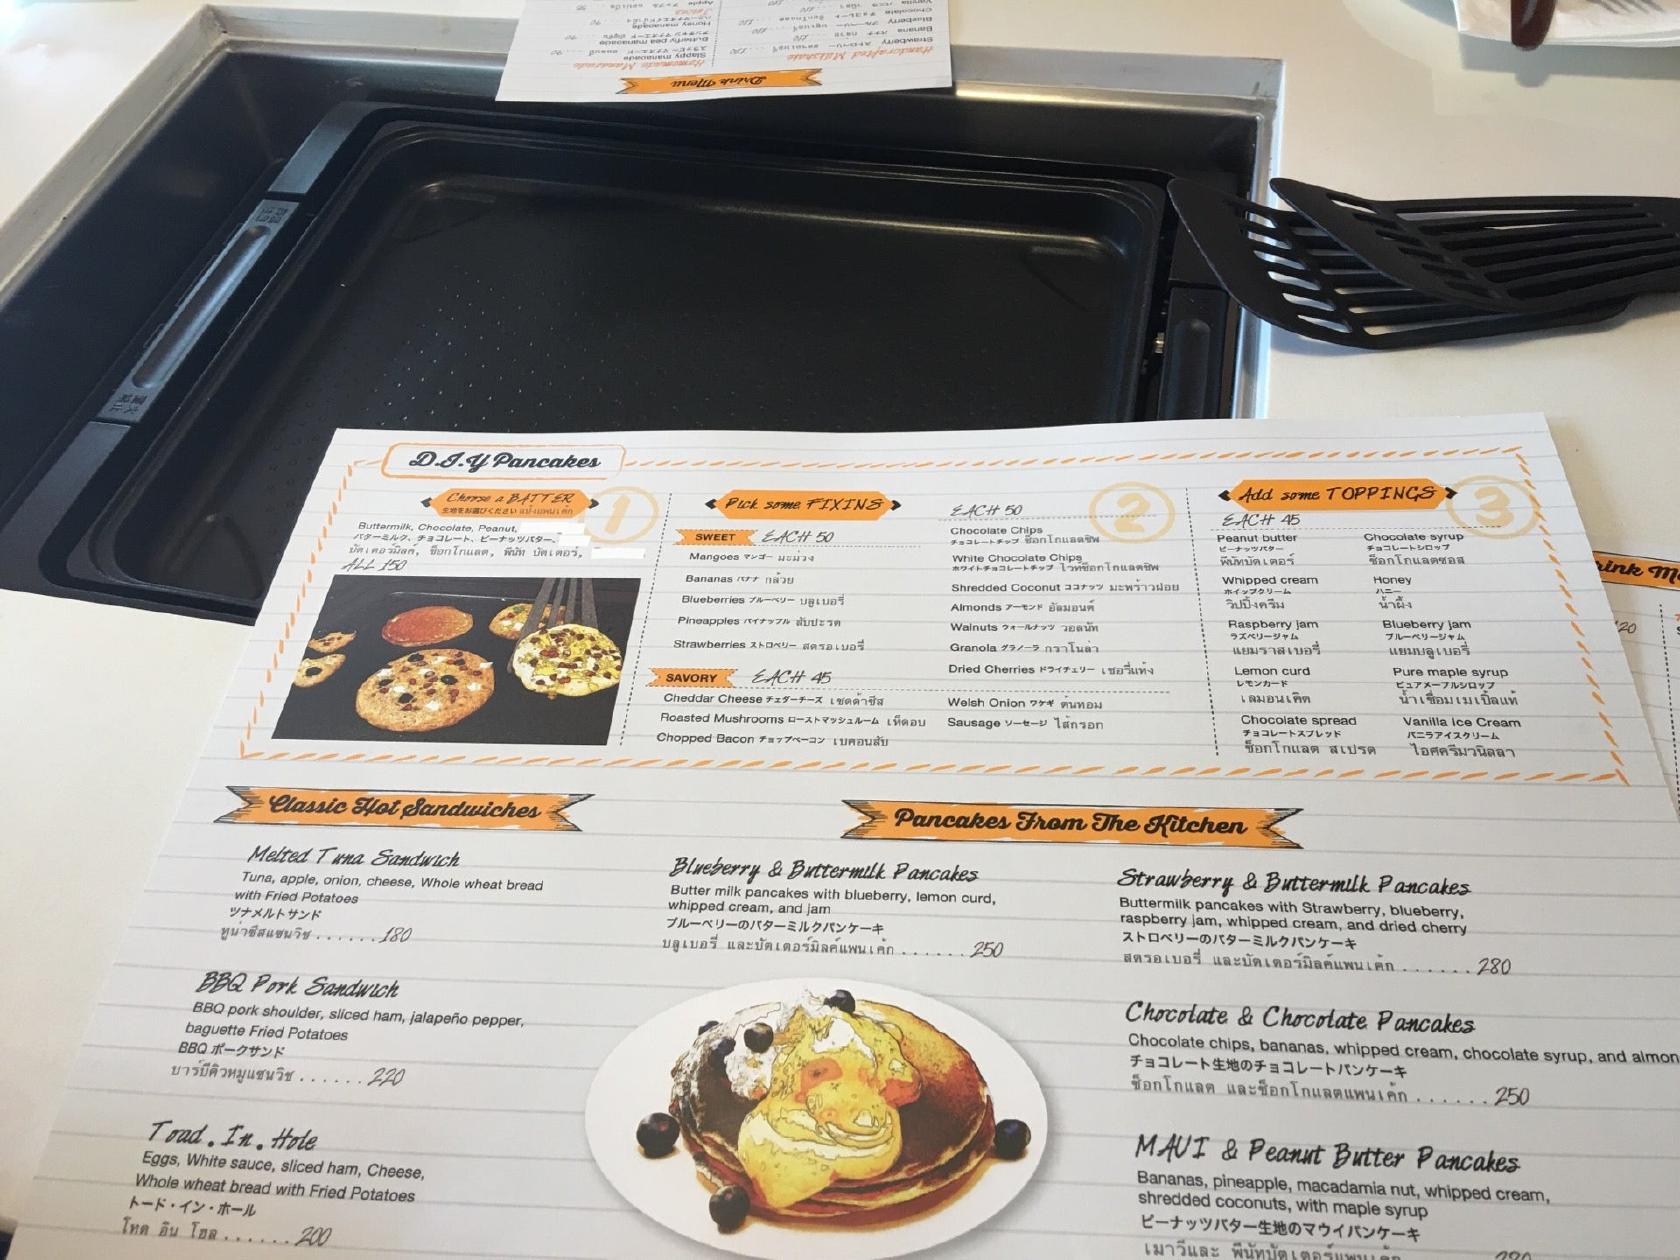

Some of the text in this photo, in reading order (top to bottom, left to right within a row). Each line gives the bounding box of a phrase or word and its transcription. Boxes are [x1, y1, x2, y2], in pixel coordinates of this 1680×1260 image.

[671, 75, 767, 88] Drink Menu
[493, 452, 601, 468] Pancakes
[446, 490, 575, 506] Choose a BATTER
[1238, 486, 1437, 503] Add some TOPPINGS
[725, 497, 884, 512] Pick some FIXINS
[950, 504, 1022, 516] EACH 50
[1474, 486, 1515, 528] 3
[604, 495, 631, 535] 1
[1114, 492, 1151, 533] 2
[1222, 513, 1300, 526] EACH 45
[358, 522, 517, 533] Buttermilk, Chocolate, Peanut,
[1011, 526, 1043, 536] Chips
[762, 530, 834, 544] EACH 50
[1262, 534, 1297, 542] butter
[1364, 533, 1464, 542] Chocolate syrup
[690, 553, 740, 562] Mangoes
[988, 554, 1046, 562] Chocolate
[1049, 554, 1085, 564] Chips
[341, 558, 407, 572] ALL 150
[686, 575, 733, 583] Bananas
[1222, 576, 1276, 586] Whipped
[1374, 576, 1411, 585] Honey
[952, 584, 1060, 592] Shredded Coconut
[682, 595, 745, 604] Blueberries
[951, 604, 1002, 612] Almonds
[678, 616, 740, 626] Pineapples
[950, 622, 998, 632] Walnuts
[1228, 620, 1318, 630] Raspberry jam
[1382, 620, 1471, 631] Blueberry jam
[674, 640, 746, 648] Strawberries
[950, 643, 997, 652] Granola
[949, 664, 1035, 674] Dried Cherries
[1235, 666, 1310, 676] Lemon curd
[1393, 668, 1508, 678] Pure maple syrup
[666, 674, 718, 683] SAVORY
[752, 669, 832, 686] EACH 45
[664, 693, 762, 704] Cheddar Cheese
[948, 698, 1025, 708] Welsh Onion
[661, 713, 784, 724] Roasted Mushrooms
[948, 718, 1000, 730] Sausage
[1241, 715, 1356, 727] Chocolate spread
[1403, 717, 1521, 727] Vanilla Ice Cream
[657, 732, 754, 744] Chopped Bacon
[269, 794, 542, 820] Classic Hot Sandwiches
[894, 808, 1248, 838] Pancakes From The Kitchen
[247, 845, 460, 867] Melted Tuna Sandwich
[669, 857, 978, 883] Blueberry & Buttermilk Pancakes
[243, 872, 543, 891] Tuna, apple, onion, cheese, Whole wheat bread
[1117, 868, 1472, 898] Strawberry & Buttermilk Pancakes
[668, 900, 830, 916] whipped cream, and jam
[378, 927, 412, 943] 180
[970, 942, 1004, 958] 250
[1477, 958, 1511, 976] 280
[195, 971, 399, 998] BBQ Pork Sandwich
[1126, 1000, 1476, 1034] Chocolate & Chocolate Pancakes
[178, 1042, 208, 1054] BBQ
[367, 1067, 405, 1086] 220
[1494, 1087, 1530, 1106] 250
[1135, 1134, 1521, 1173] MAUI & Peanut Butter Pancakes
[1138, 1191, 1428, 1221] shredded coconuts, with maple syrup
[294, 1226, 332, 1247] 200
